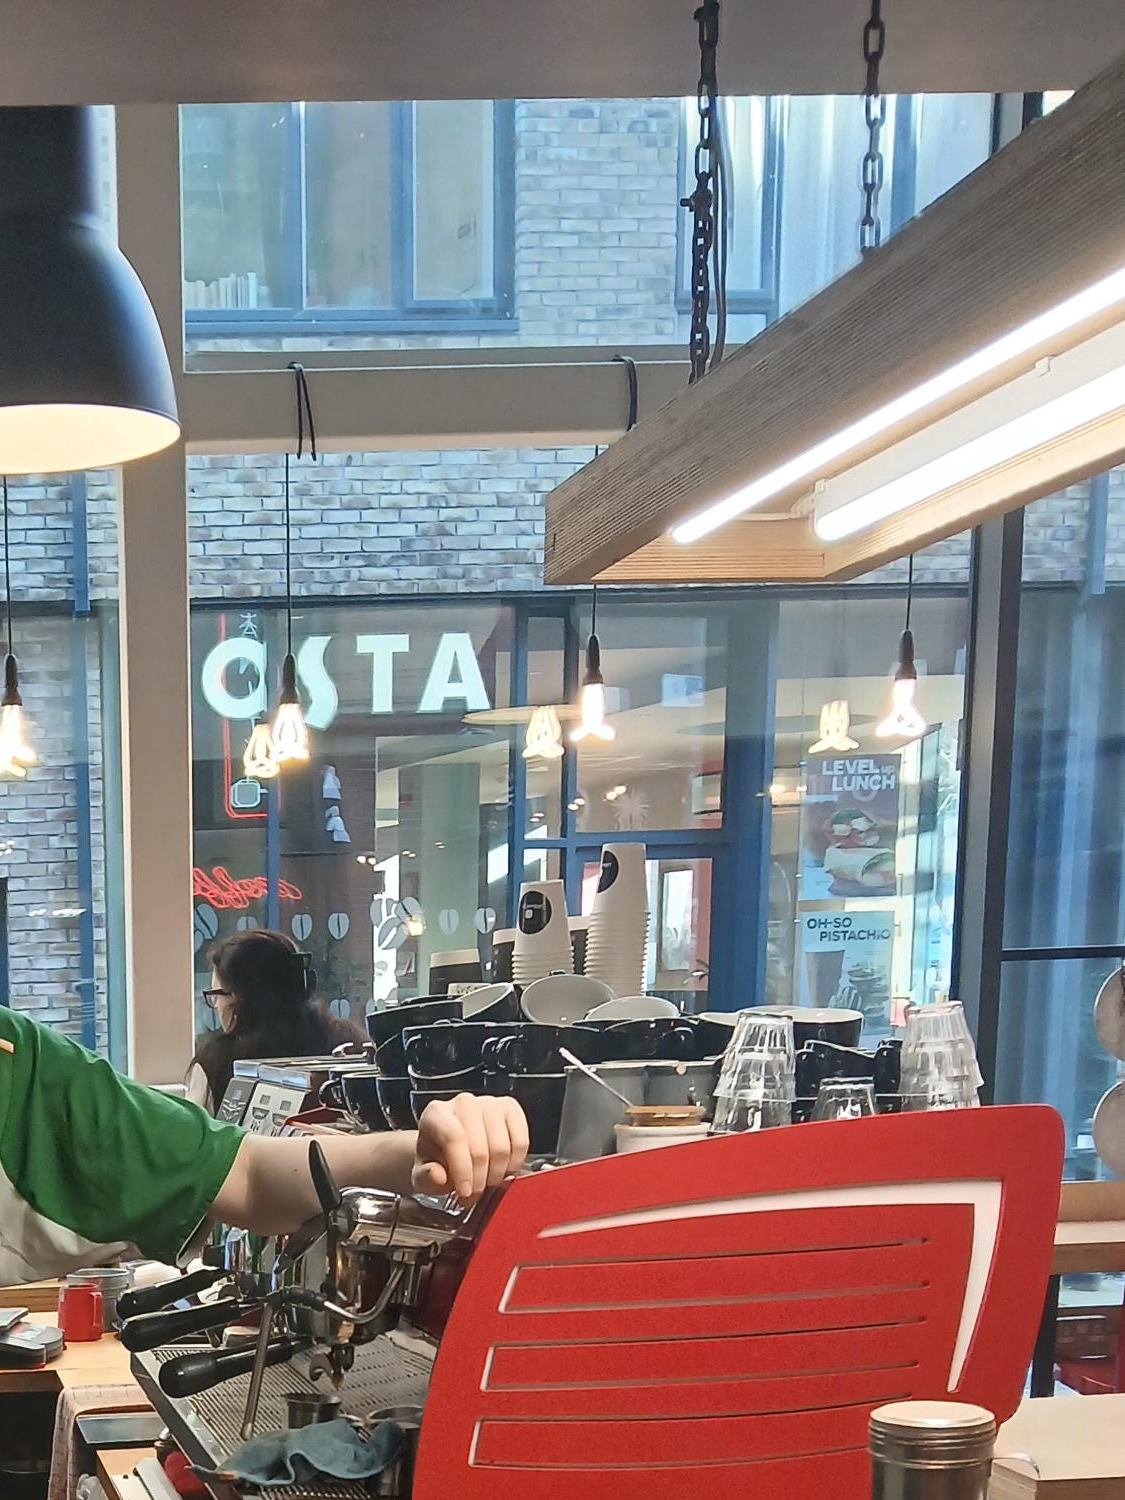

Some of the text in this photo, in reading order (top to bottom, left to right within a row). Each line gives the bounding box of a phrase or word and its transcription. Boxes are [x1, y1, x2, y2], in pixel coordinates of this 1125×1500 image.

[202, 633, 491, 731] OSTA
[822, 758, 880, 776] LEVEL
[832, 774, 895, 792] LUNCH
[807, 917, 852, 929] OH-SO
[819, 929, 891, 942] PISTACHIO
